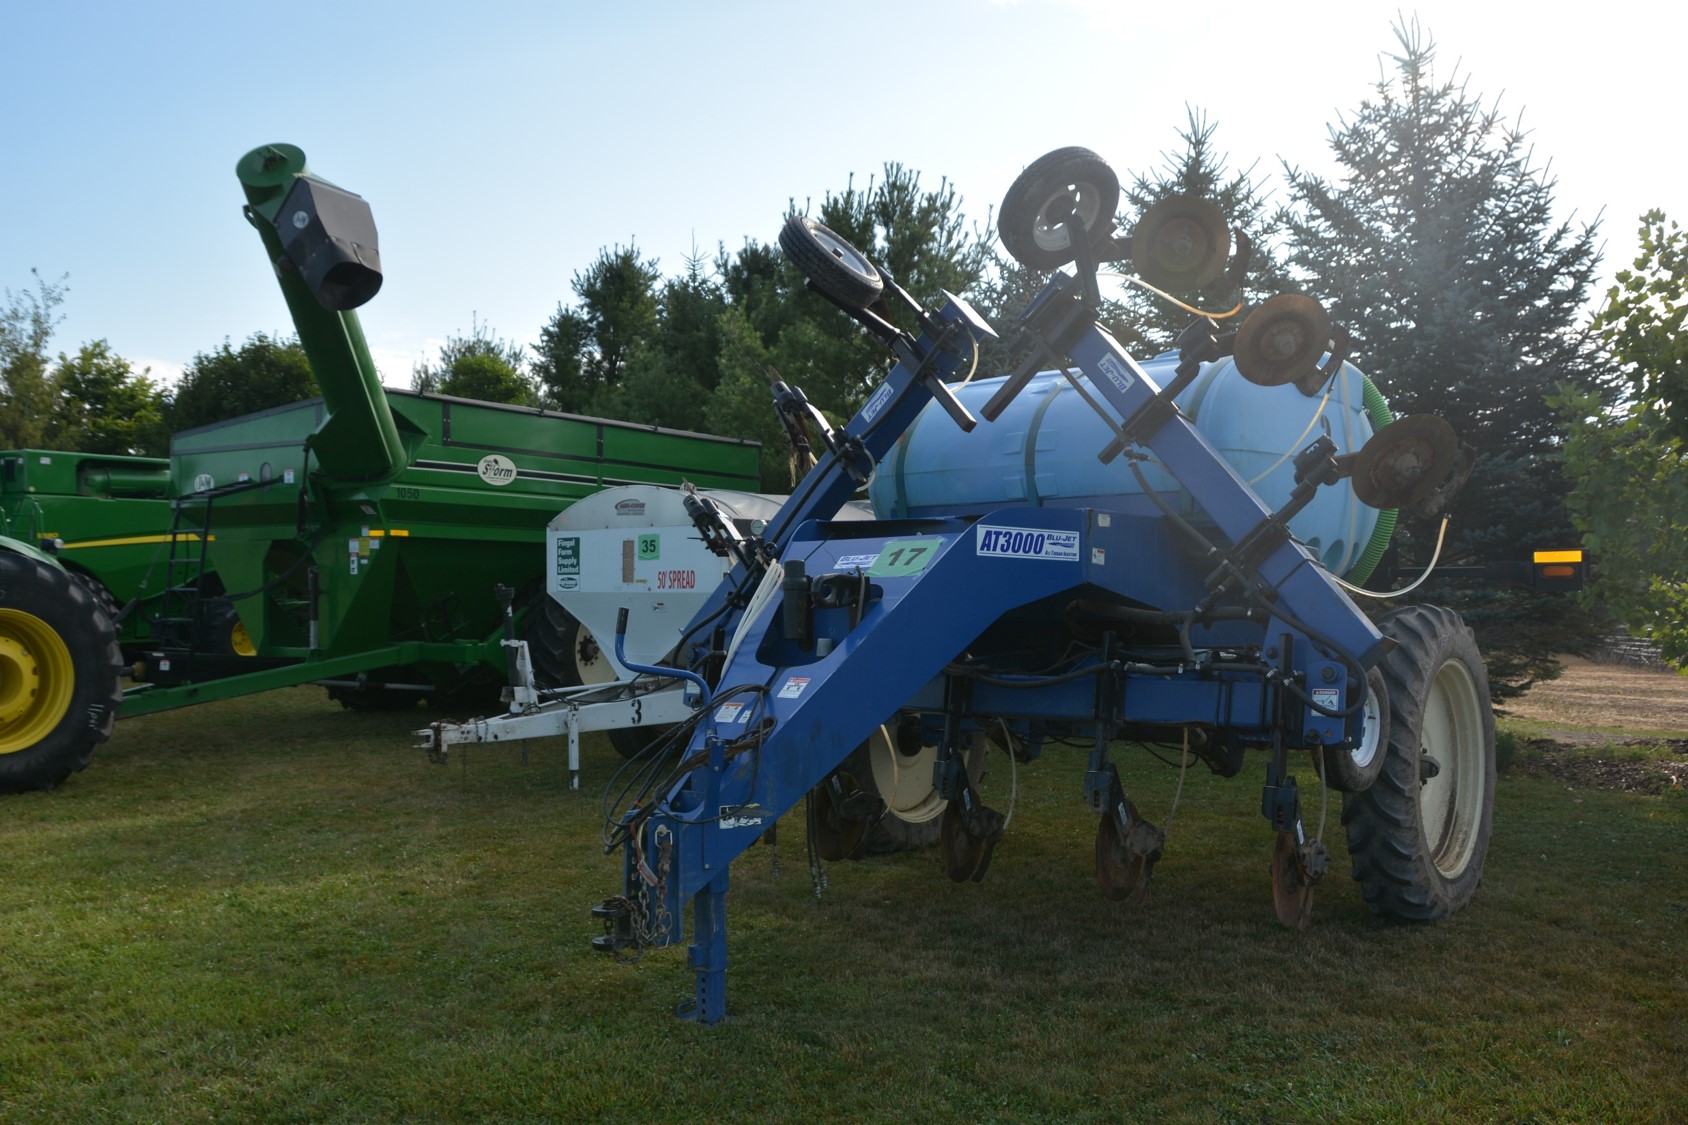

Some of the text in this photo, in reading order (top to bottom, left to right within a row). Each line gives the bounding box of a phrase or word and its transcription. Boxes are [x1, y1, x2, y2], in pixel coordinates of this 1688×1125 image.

[396, 487, 420, 500] 1050
[558, 538, 575, 548] Fingal
[980, 530, 1046, 555] AT3000
[1046, 534, 1077, 542] BLU-JET
[558, 548, 573, 556] Farm
[641, 539, 656, 553] 35
[558, 556, 577, 566] Supply
[888, 547, 928, 567] 17
[558, 565, 579, 574] Limited
[657, 570, 696, 589] 50' SPREAD
[631, 699, 642, 725] 3
